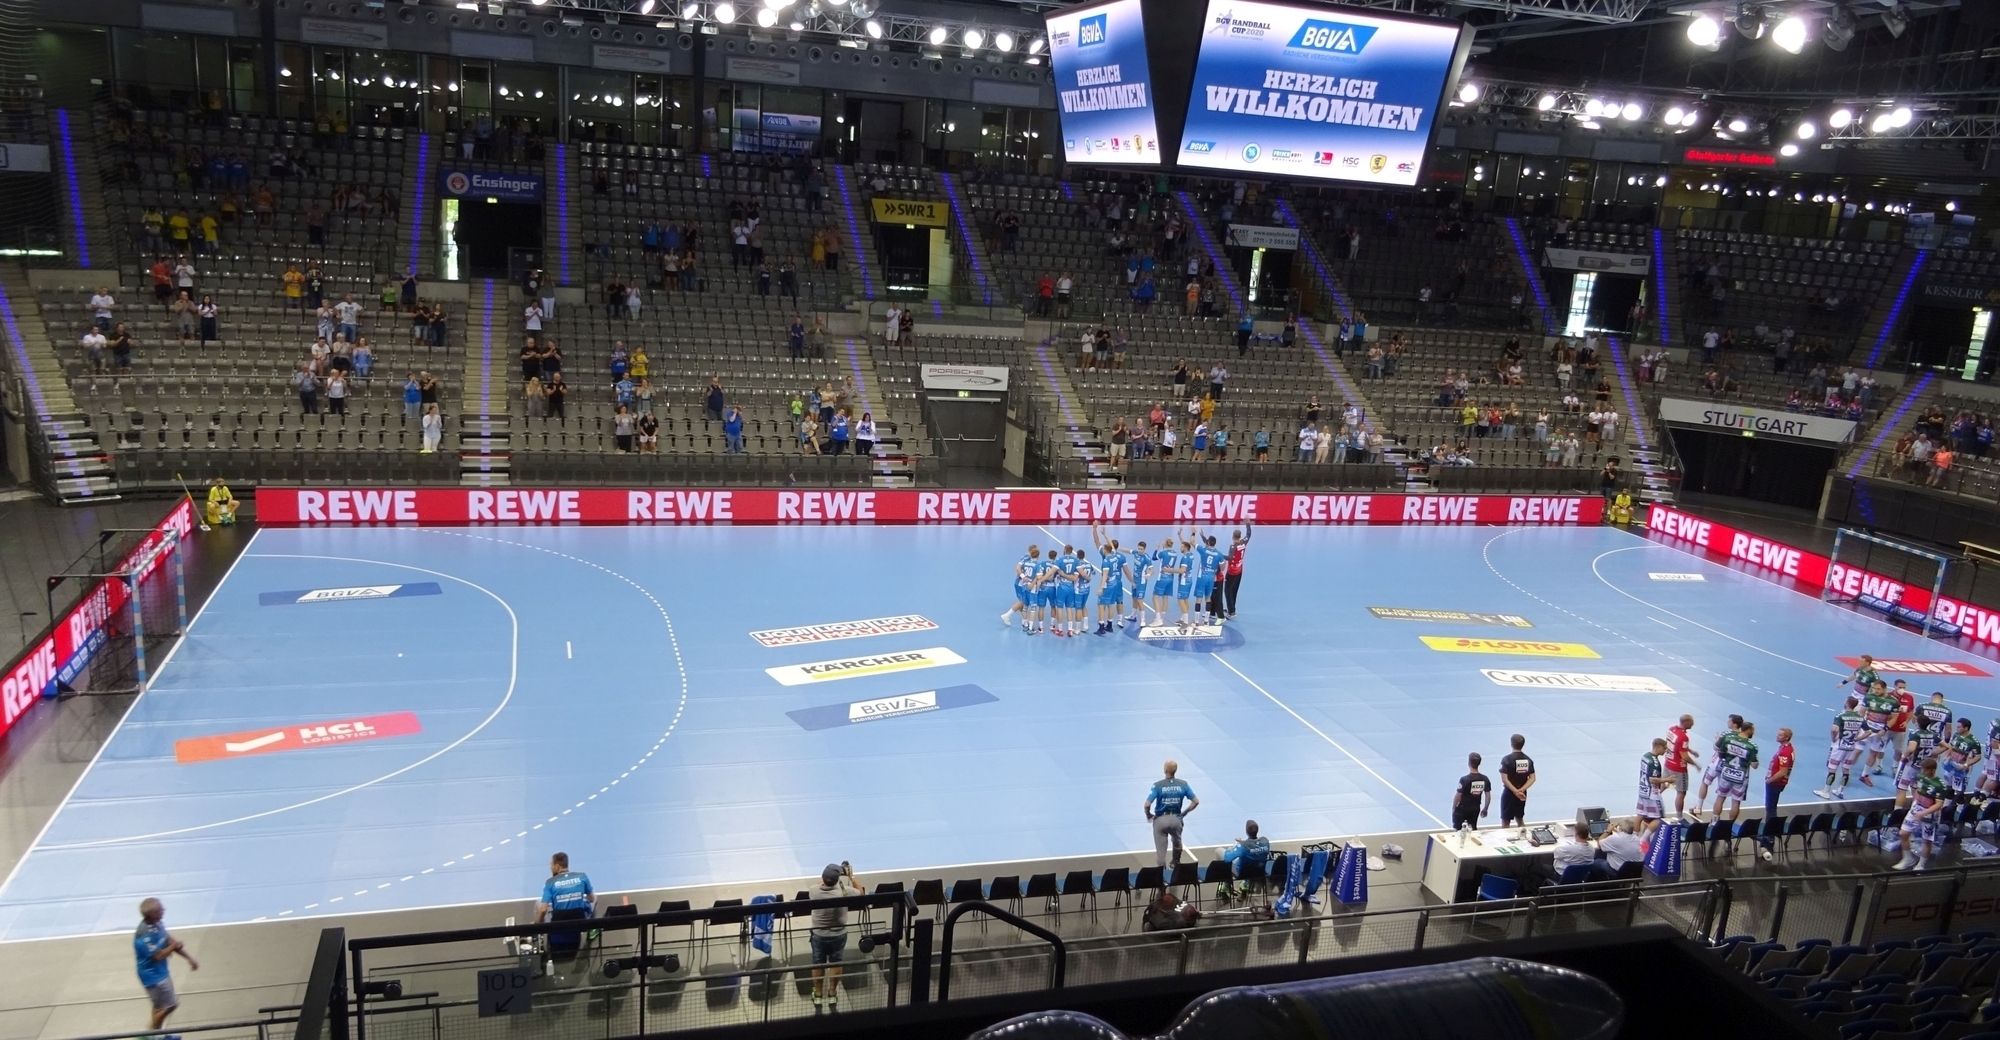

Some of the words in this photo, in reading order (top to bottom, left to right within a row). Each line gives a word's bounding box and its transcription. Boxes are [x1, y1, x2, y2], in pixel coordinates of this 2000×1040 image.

[1232, 19, 1271, 30] HANDBALL
[1232, 27, 1246, 35] CUP
[1246, 28, 1264, 36] 2020
[1283, 49, 1310, 59] BADISCHE
[1076, 64, 1121, 87] HERZLICH
[1263, 69, 1378, 100] HERZLICH
[1061, 82, 1147, 113] WILLKOMMEN
[1205, 85, 1423, 132] WILLKOMMEN
[1343, 156, 1359, 165] HSG
[472, 175, 537, 192] Ensinger
[1925, 285, 1983, 299] KESSLER
[1703, 411, 1808, 436] STUTTGART
[298, 490, 418, 520] REWE
[469, 490, 581, 520] REWE
[628, 491, 733, 519] REWE
[777, 491, 876, 519] REWE
[917, 492, 1011, 519] REWE
[1050, 493, 1137, 519] REWE
[1174, 494, 1258, 519] REWE
[1292, 495, 1371, 520] REWE
[1403, 496, 1479, 521] REWE
[1508, 498, 1581, 521] REWE
[1651, 507, 1710, 546] REWE
[1731, 533, 1802, 577] REWE
[1066, 563, 1073, 574] 17
[756, 628, 811, 639] LIQUI
[815, 622, 869, 633] LIQUI
[872, 616, 924, 627] LIQUI
[761, 634, 816, 645] MOLY
[823, 628, 876, 639] MOLY
[883, 622, 931, 632] MOLY
[1483, 640, 1561, 651] LOTTO
[801, 653, 927, 674] KÄRCHER
[1871, 660, 1967, 675] REWE
[2, 638, 57, 725] REWE
[1486, 670, 1600, 687] ComTel
[851, 713, 884, 723] BADISCHE
[883, 705, 940, 718] VERSICHERUNGEN
[300, 721, 375, 739] HCL
[303, 730, 377, 744] LOGISTICS
[1729, 756, 1741, 769] 4
[1649, 824, 1667, 869] wohninvest
[1667, 826, 1679, 874] wohninvest
[554, 877, 581, 888] MONTEL
[1335, 847, 1352, 896] wohninvest
[1353, 849, 1364, 900] wohninvest
[1883, 897, 2000, 925] PORS
[482, 973, 505, 991] 10
[511, 972, 527, 989] b
